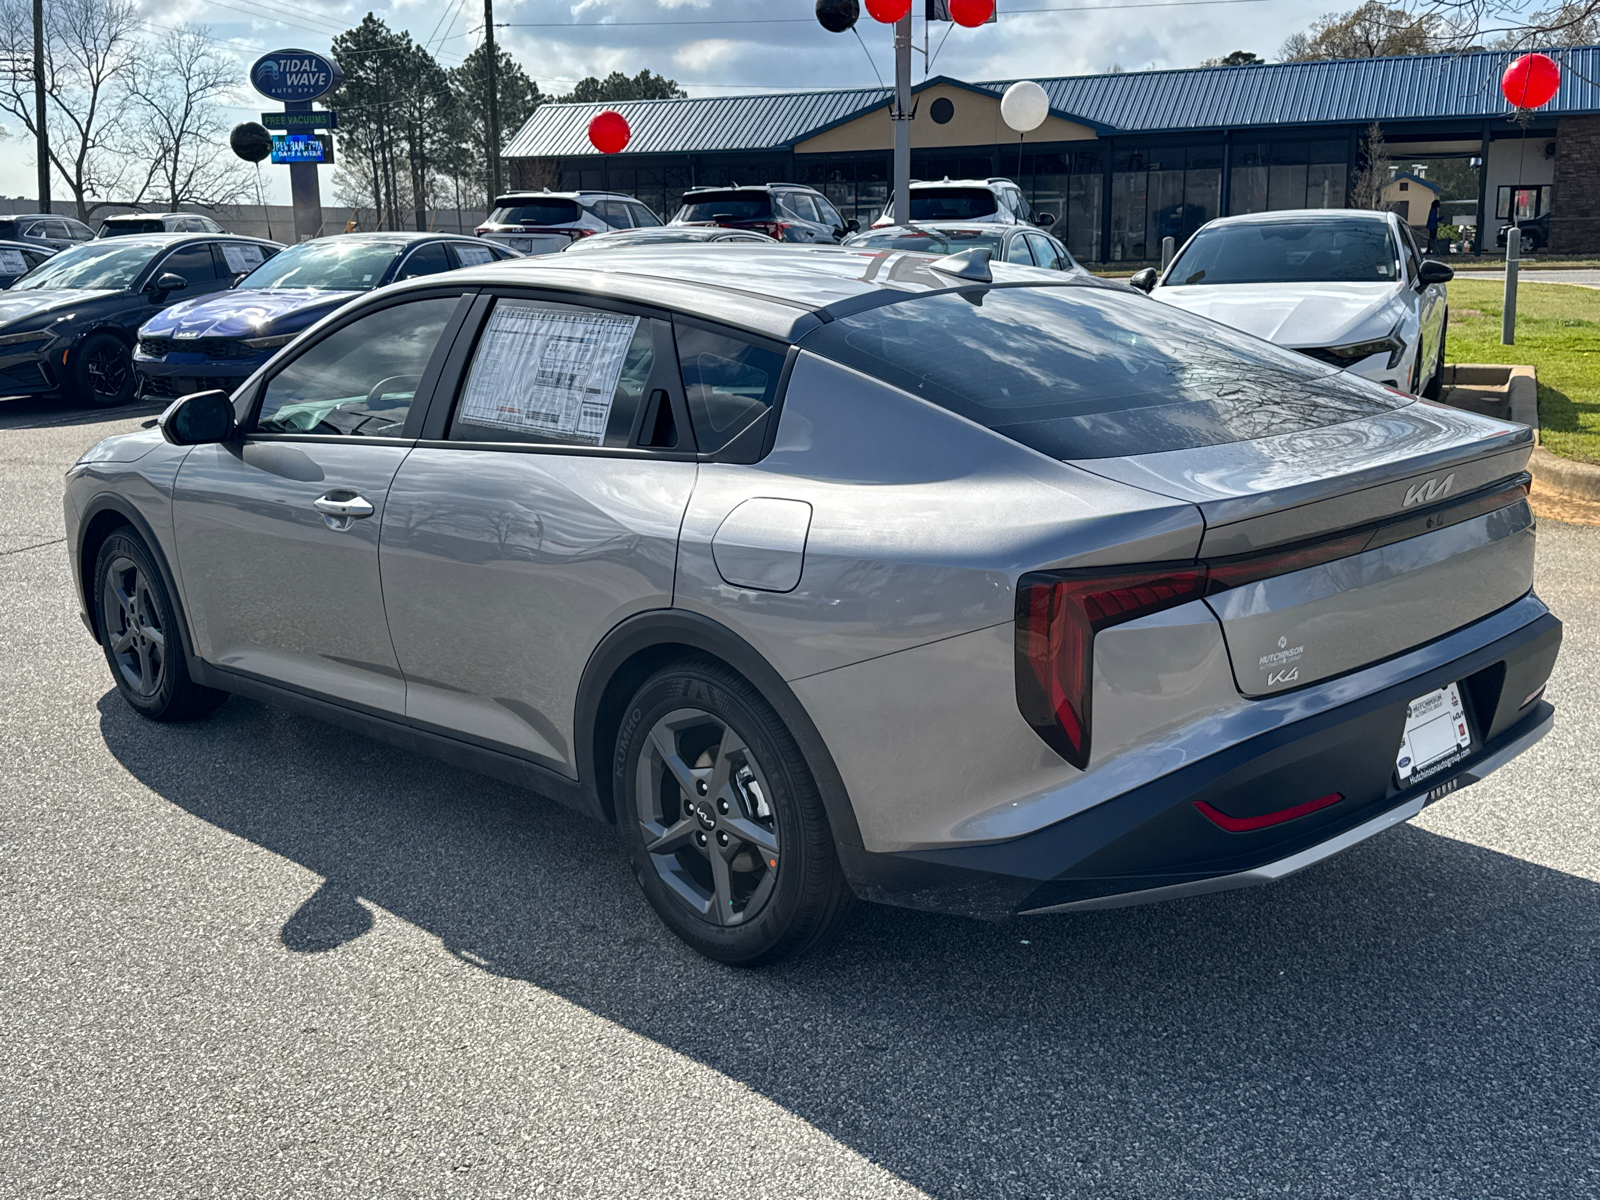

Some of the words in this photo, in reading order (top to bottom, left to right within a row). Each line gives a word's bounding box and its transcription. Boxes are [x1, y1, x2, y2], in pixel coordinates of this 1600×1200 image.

[279, 59, 318, 71] TIDAL
[286, 73, 326, 85] WAVE
[265, 117, 286, 125] FREE
[288, 115, 326, 124] VACUUMS
[1402, 473, 1455, 507] KIA
[1259, 645, 1305, 665] HUTCHINSON
[1267, 666, 1299, 686] K4
[616, 708, 642, 778] KUMHO
